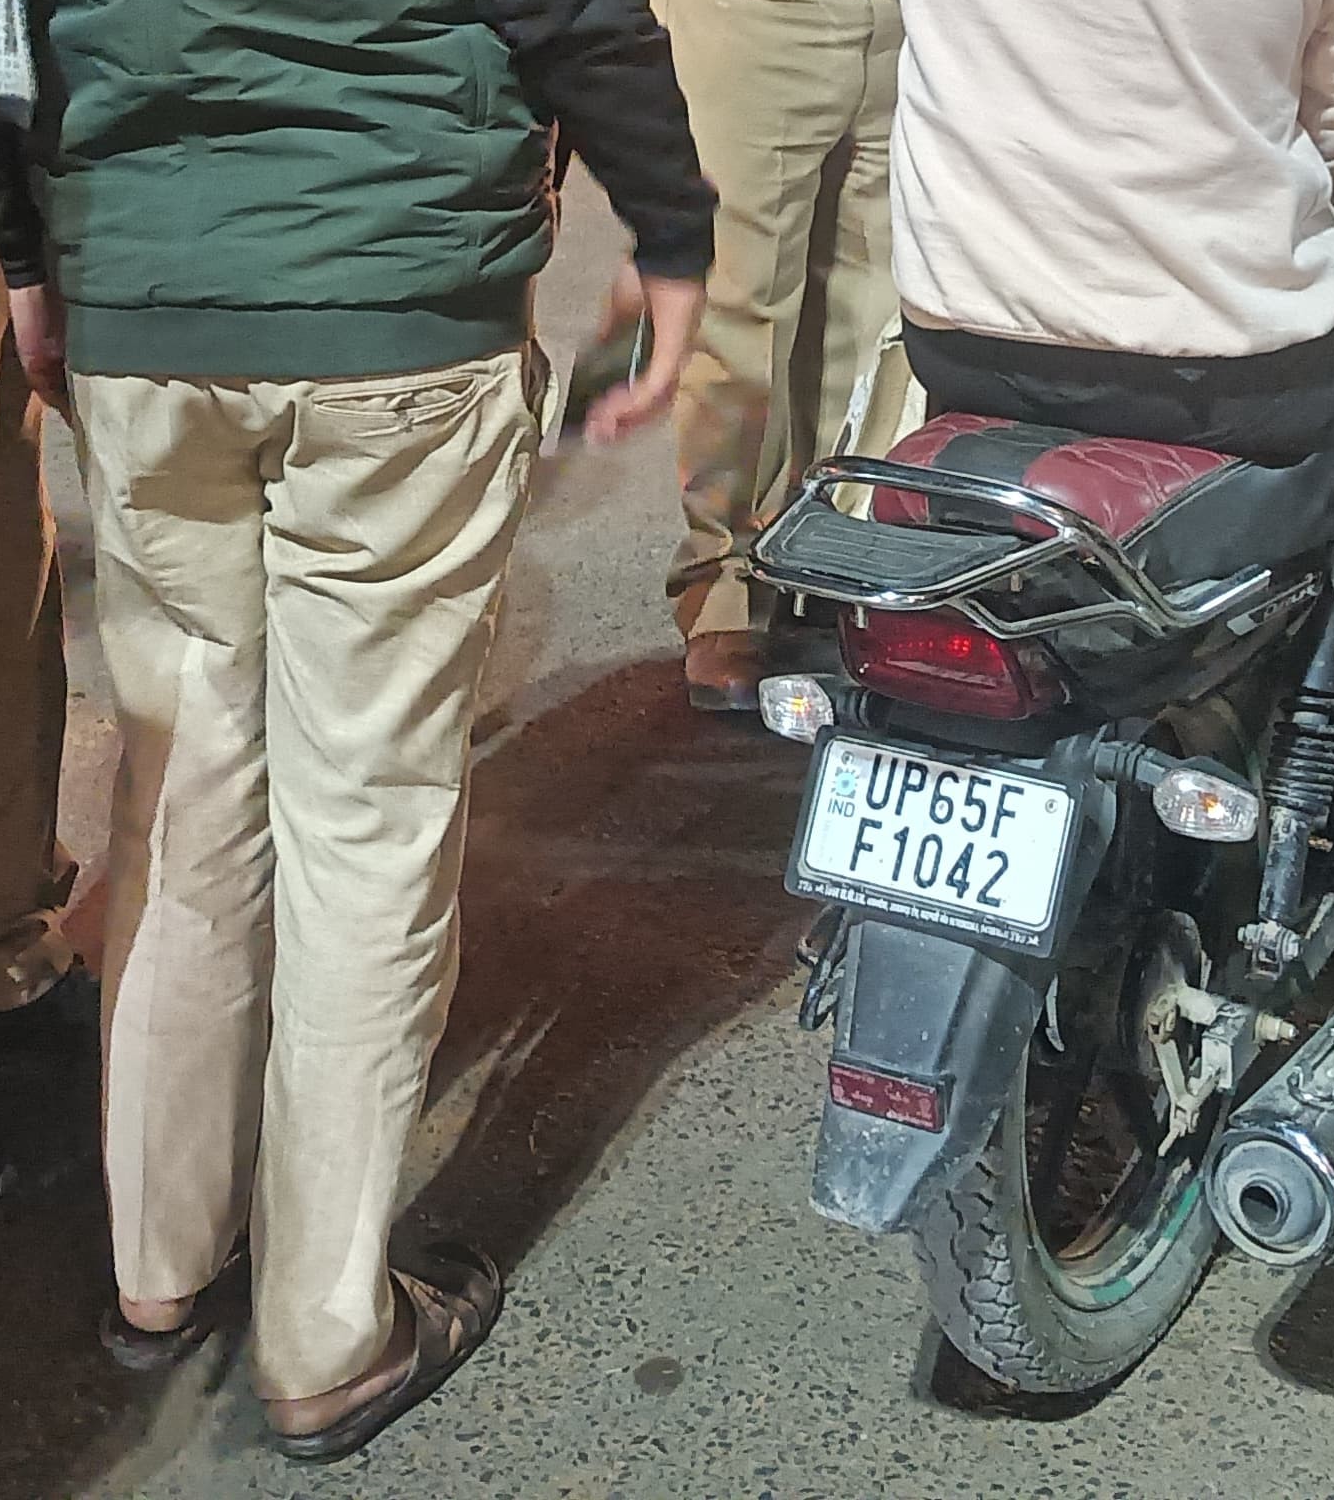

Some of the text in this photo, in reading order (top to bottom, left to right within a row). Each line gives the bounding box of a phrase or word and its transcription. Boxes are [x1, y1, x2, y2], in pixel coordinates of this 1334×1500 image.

[827, 798, 856, 819] IND
[865, 753, 1025, 839] UP65F
[849, 817, 1010, 908] F1042
